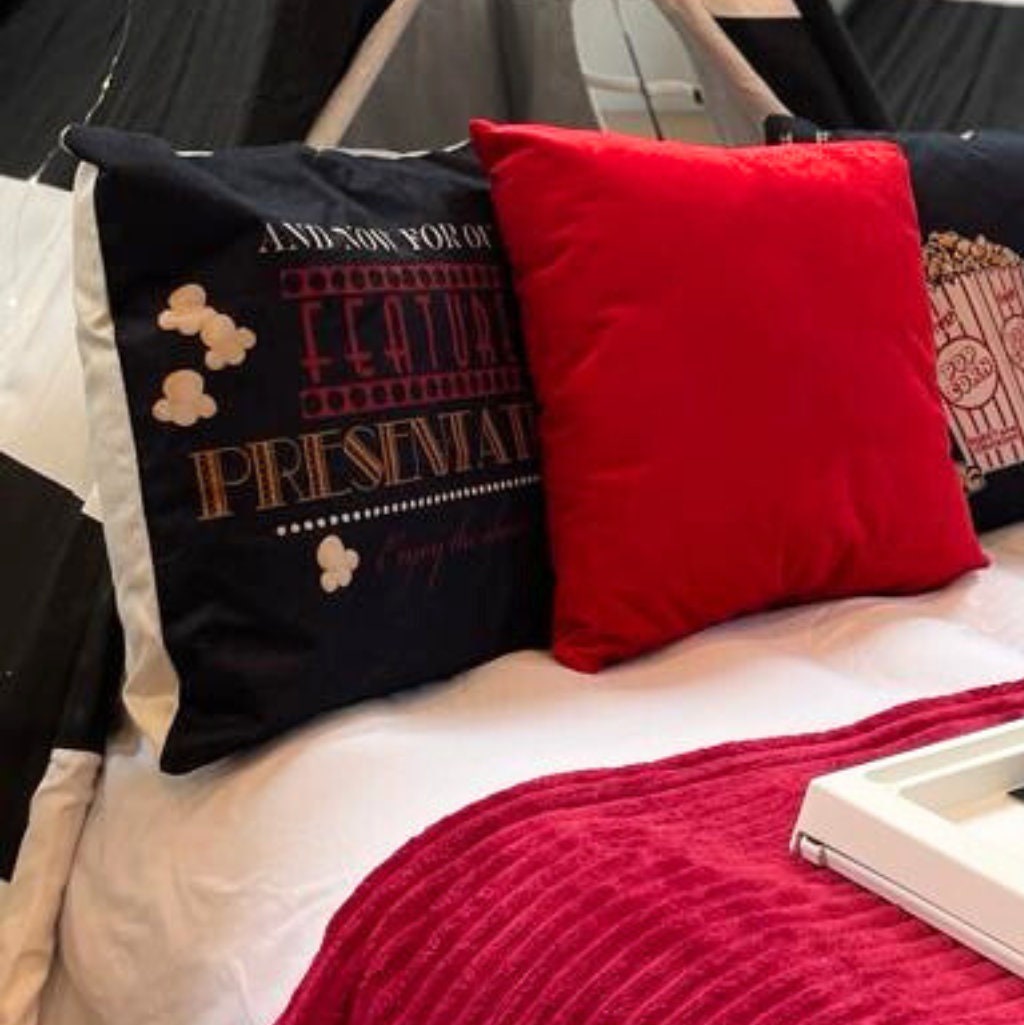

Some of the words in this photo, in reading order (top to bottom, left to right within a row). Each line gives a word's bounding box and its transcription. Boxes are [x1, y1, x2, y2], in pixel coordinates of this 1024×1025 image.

[258, 222, 333, 253] AND
[331, 225, 399, 252] NOW
[400, 222, 463, 251] FOR
